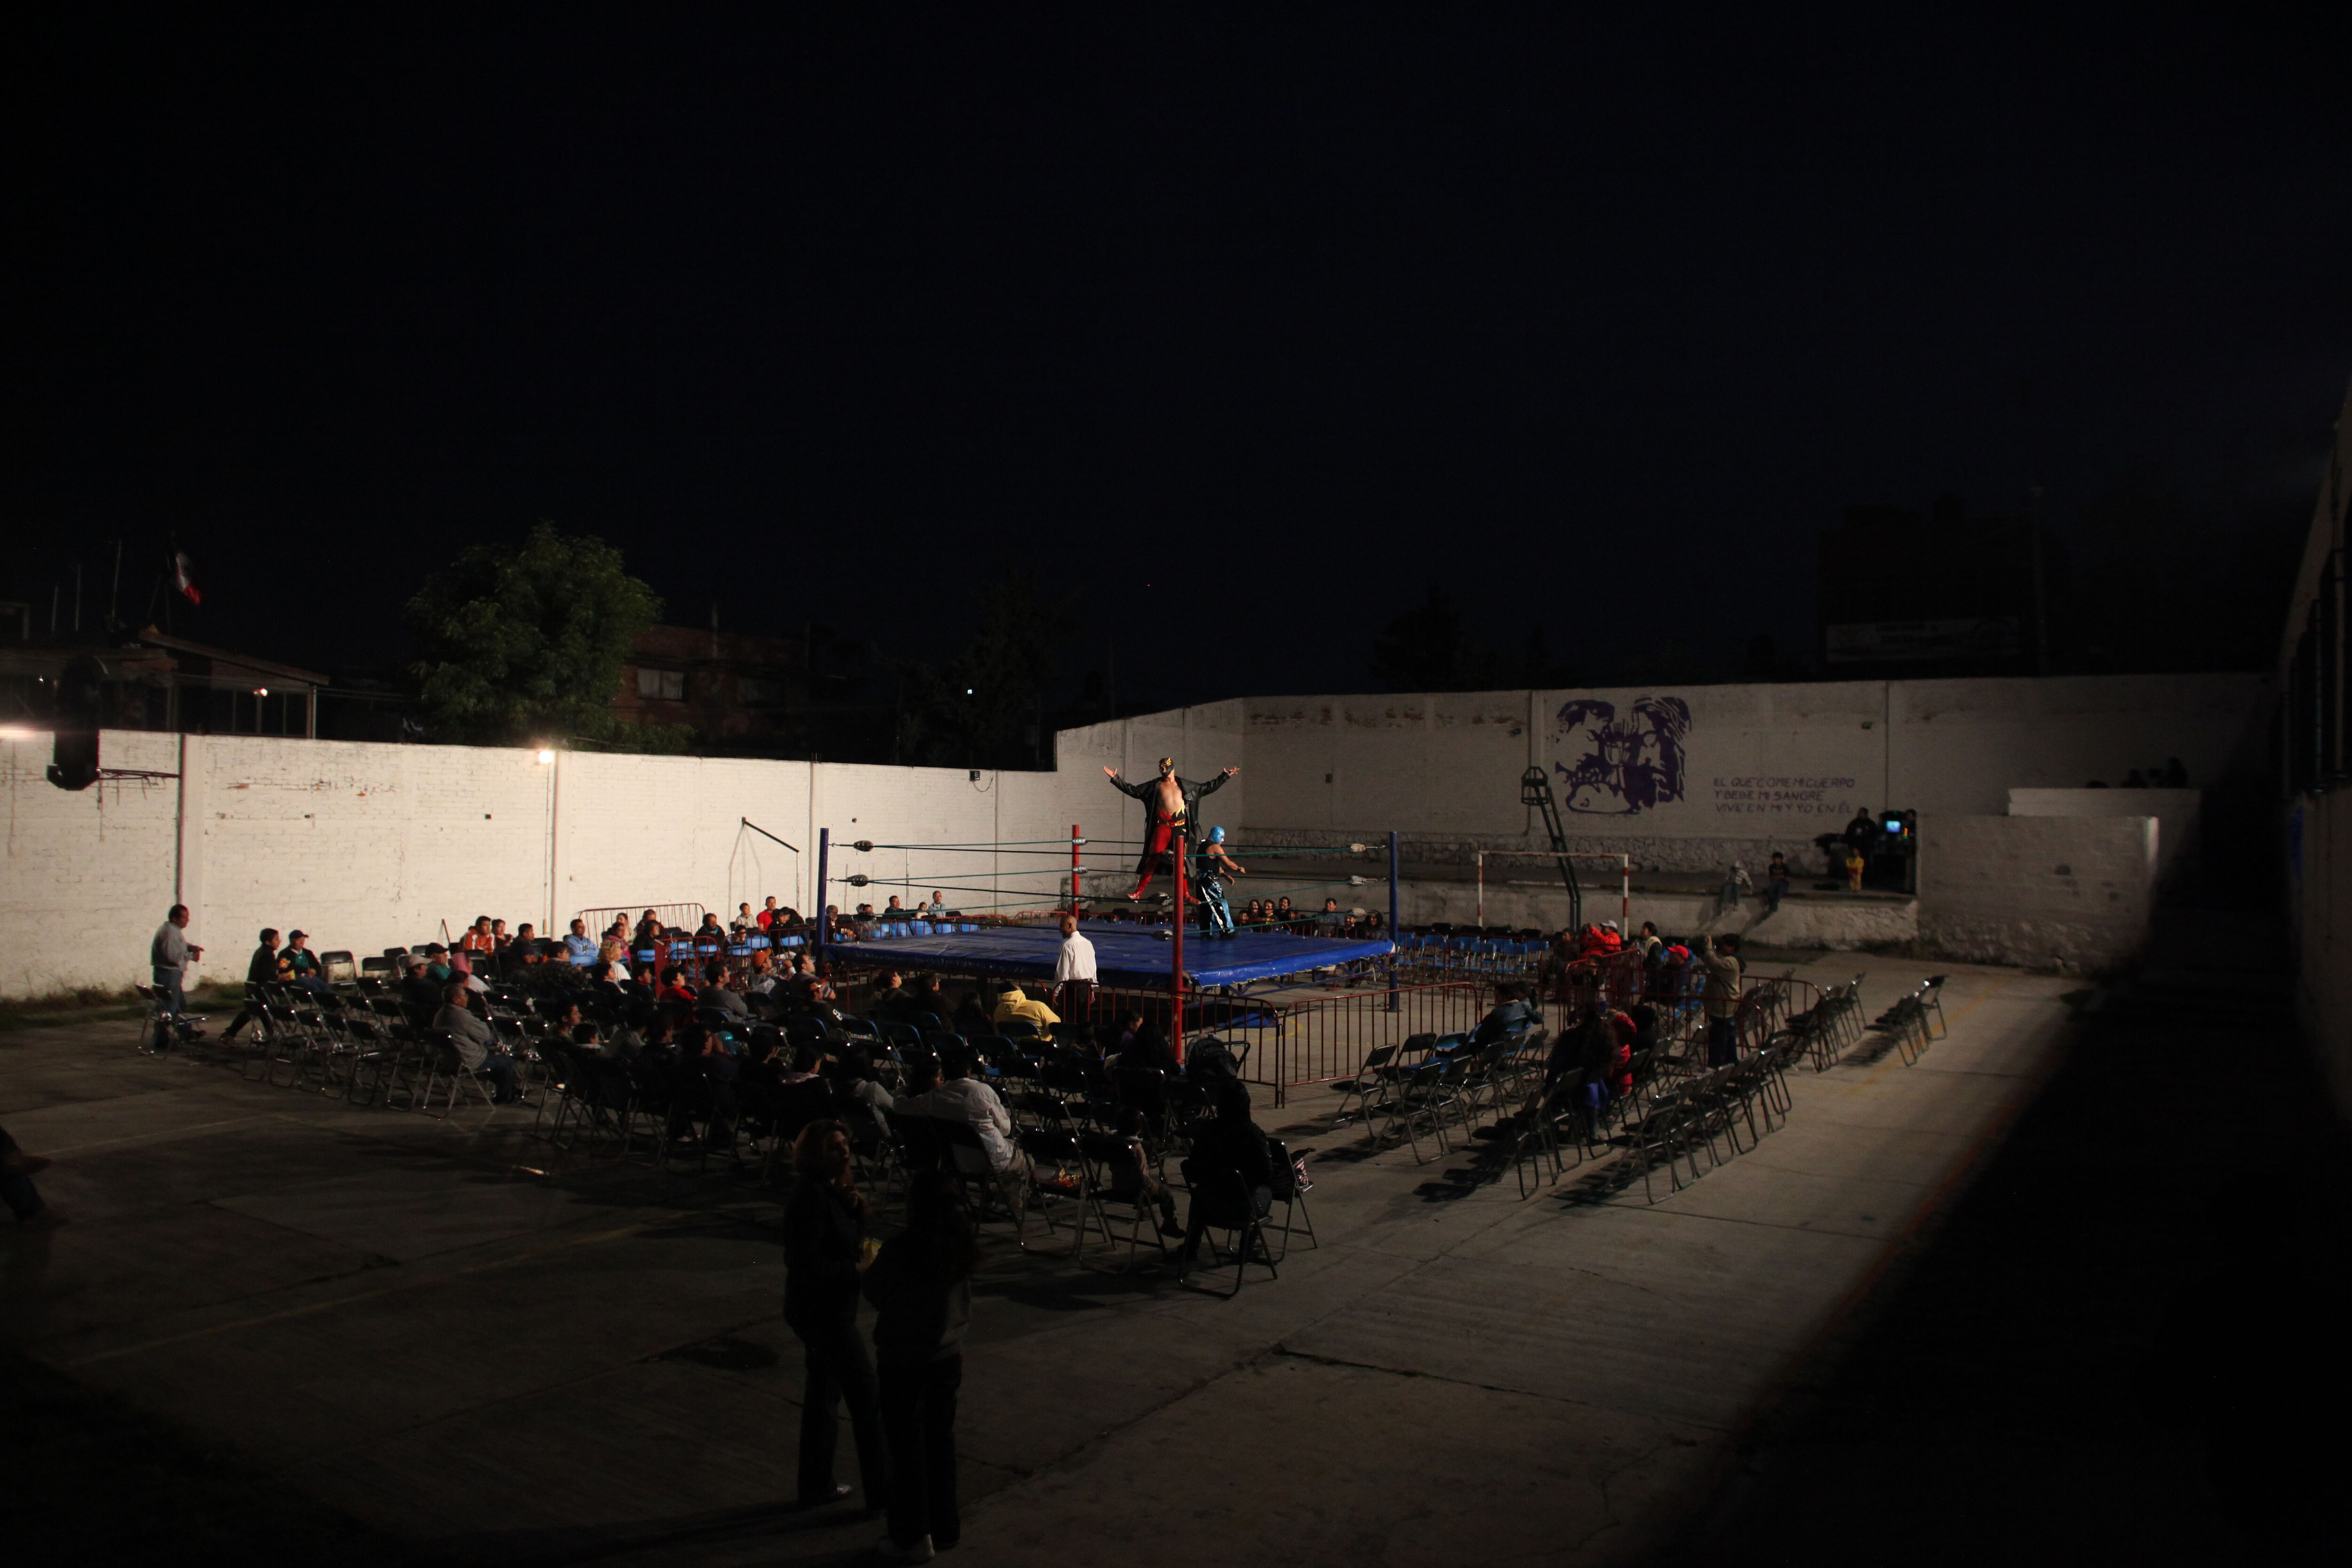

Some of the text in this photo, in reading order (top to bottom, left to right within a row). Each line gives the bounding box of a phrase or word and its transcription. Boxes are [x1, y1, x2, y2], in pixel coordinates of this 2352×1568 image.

[1714, 777, 1855, 788] EL QUE COME MI CUERPO
[1724, 790, 1754, 799] BEBE
[1758, 791, 1770, 800] MI
[1773, 790, 1825, 801] SANGRE
[1716, 804, 1743, 812] VIVE
[1747, 804, 1766, 812] EN
[1785, 803, 1792, 811] Y
[1797, 804, 1814, 813] YO
[1818, 804, 1836, 813] EN
